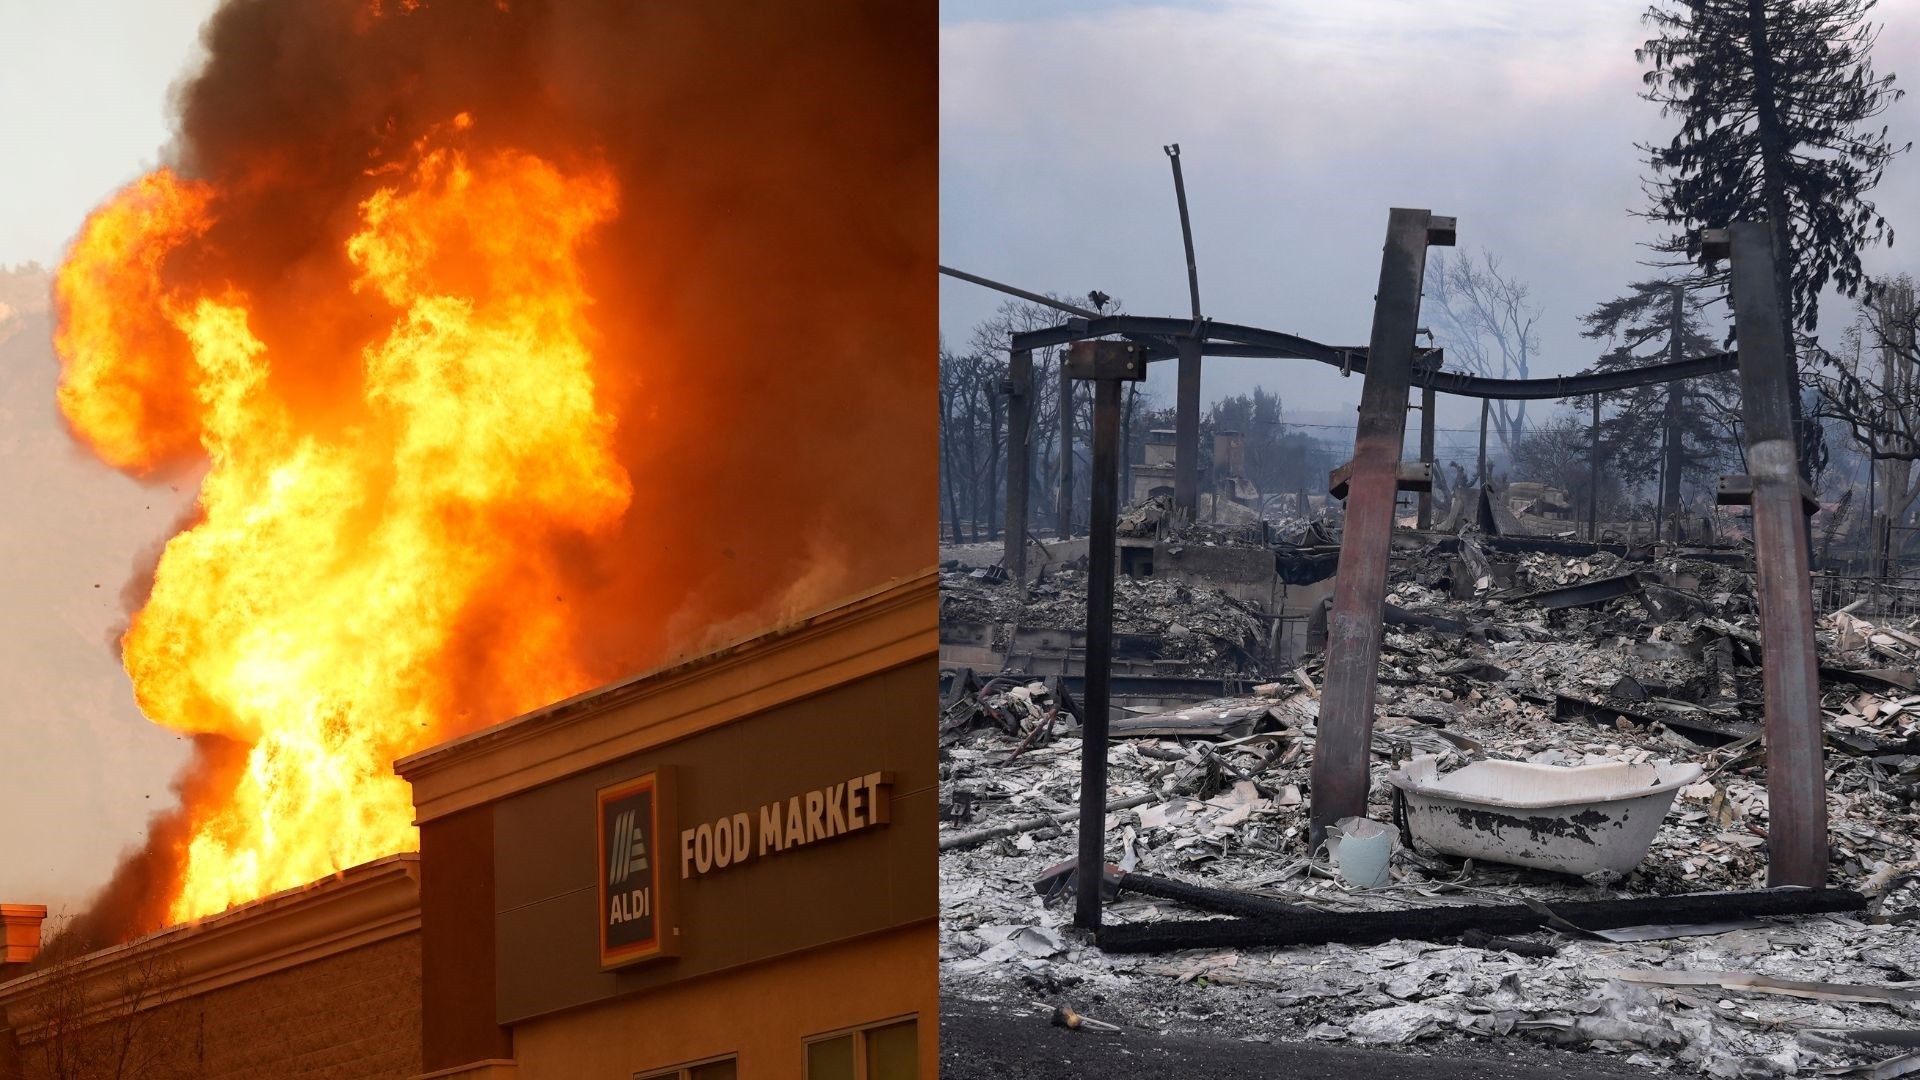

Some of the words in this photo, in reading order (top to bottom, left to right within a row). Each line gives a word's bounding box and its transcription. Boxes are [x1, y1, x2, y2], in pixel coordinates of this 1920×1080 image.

[681, 812, 751, 879] FOOD
[759, 770, 883, 856] MARKET
[609, 887, 649, 925] ALDI
